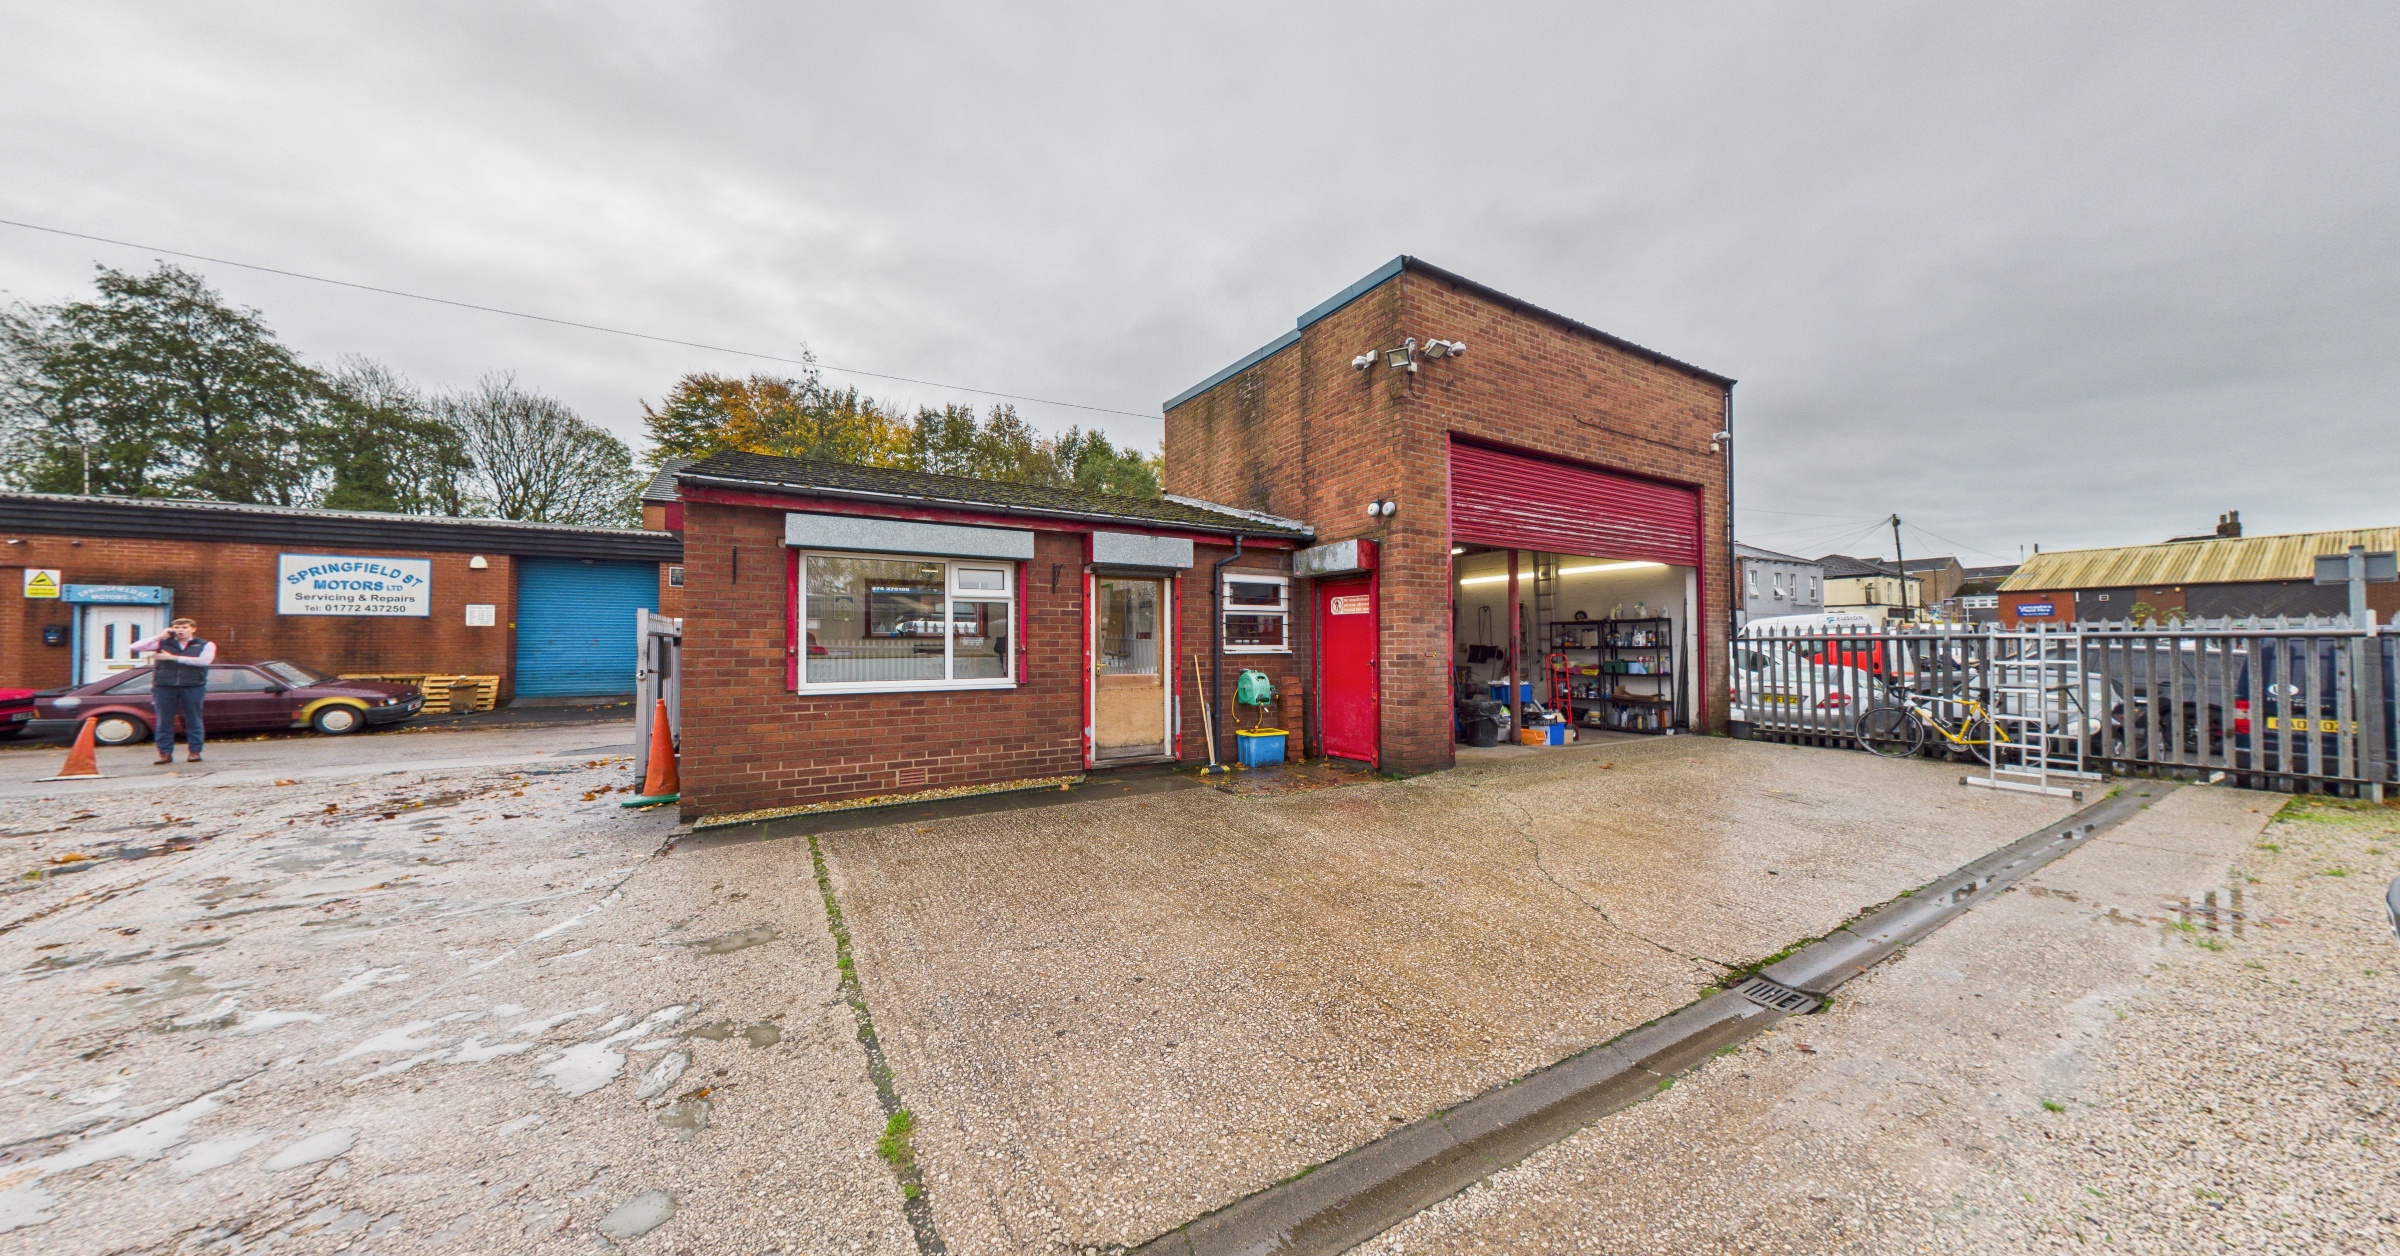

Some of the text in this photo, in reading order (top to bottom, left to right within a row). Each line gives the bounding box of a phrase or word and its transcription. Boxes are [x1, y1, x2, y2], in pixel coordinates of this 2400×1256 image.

[286, 562, 424, 588] SPRINGFIELD ST
[313, 579, 384, 591] MOTORS
[77, 585, 138, 598] SPRINGFIELD
[152, 588, 161, 599] 2
[294, 592, 416, 604] Servicing & Repairs
[304, 604, 407, 613] Tel: 01772 437250
